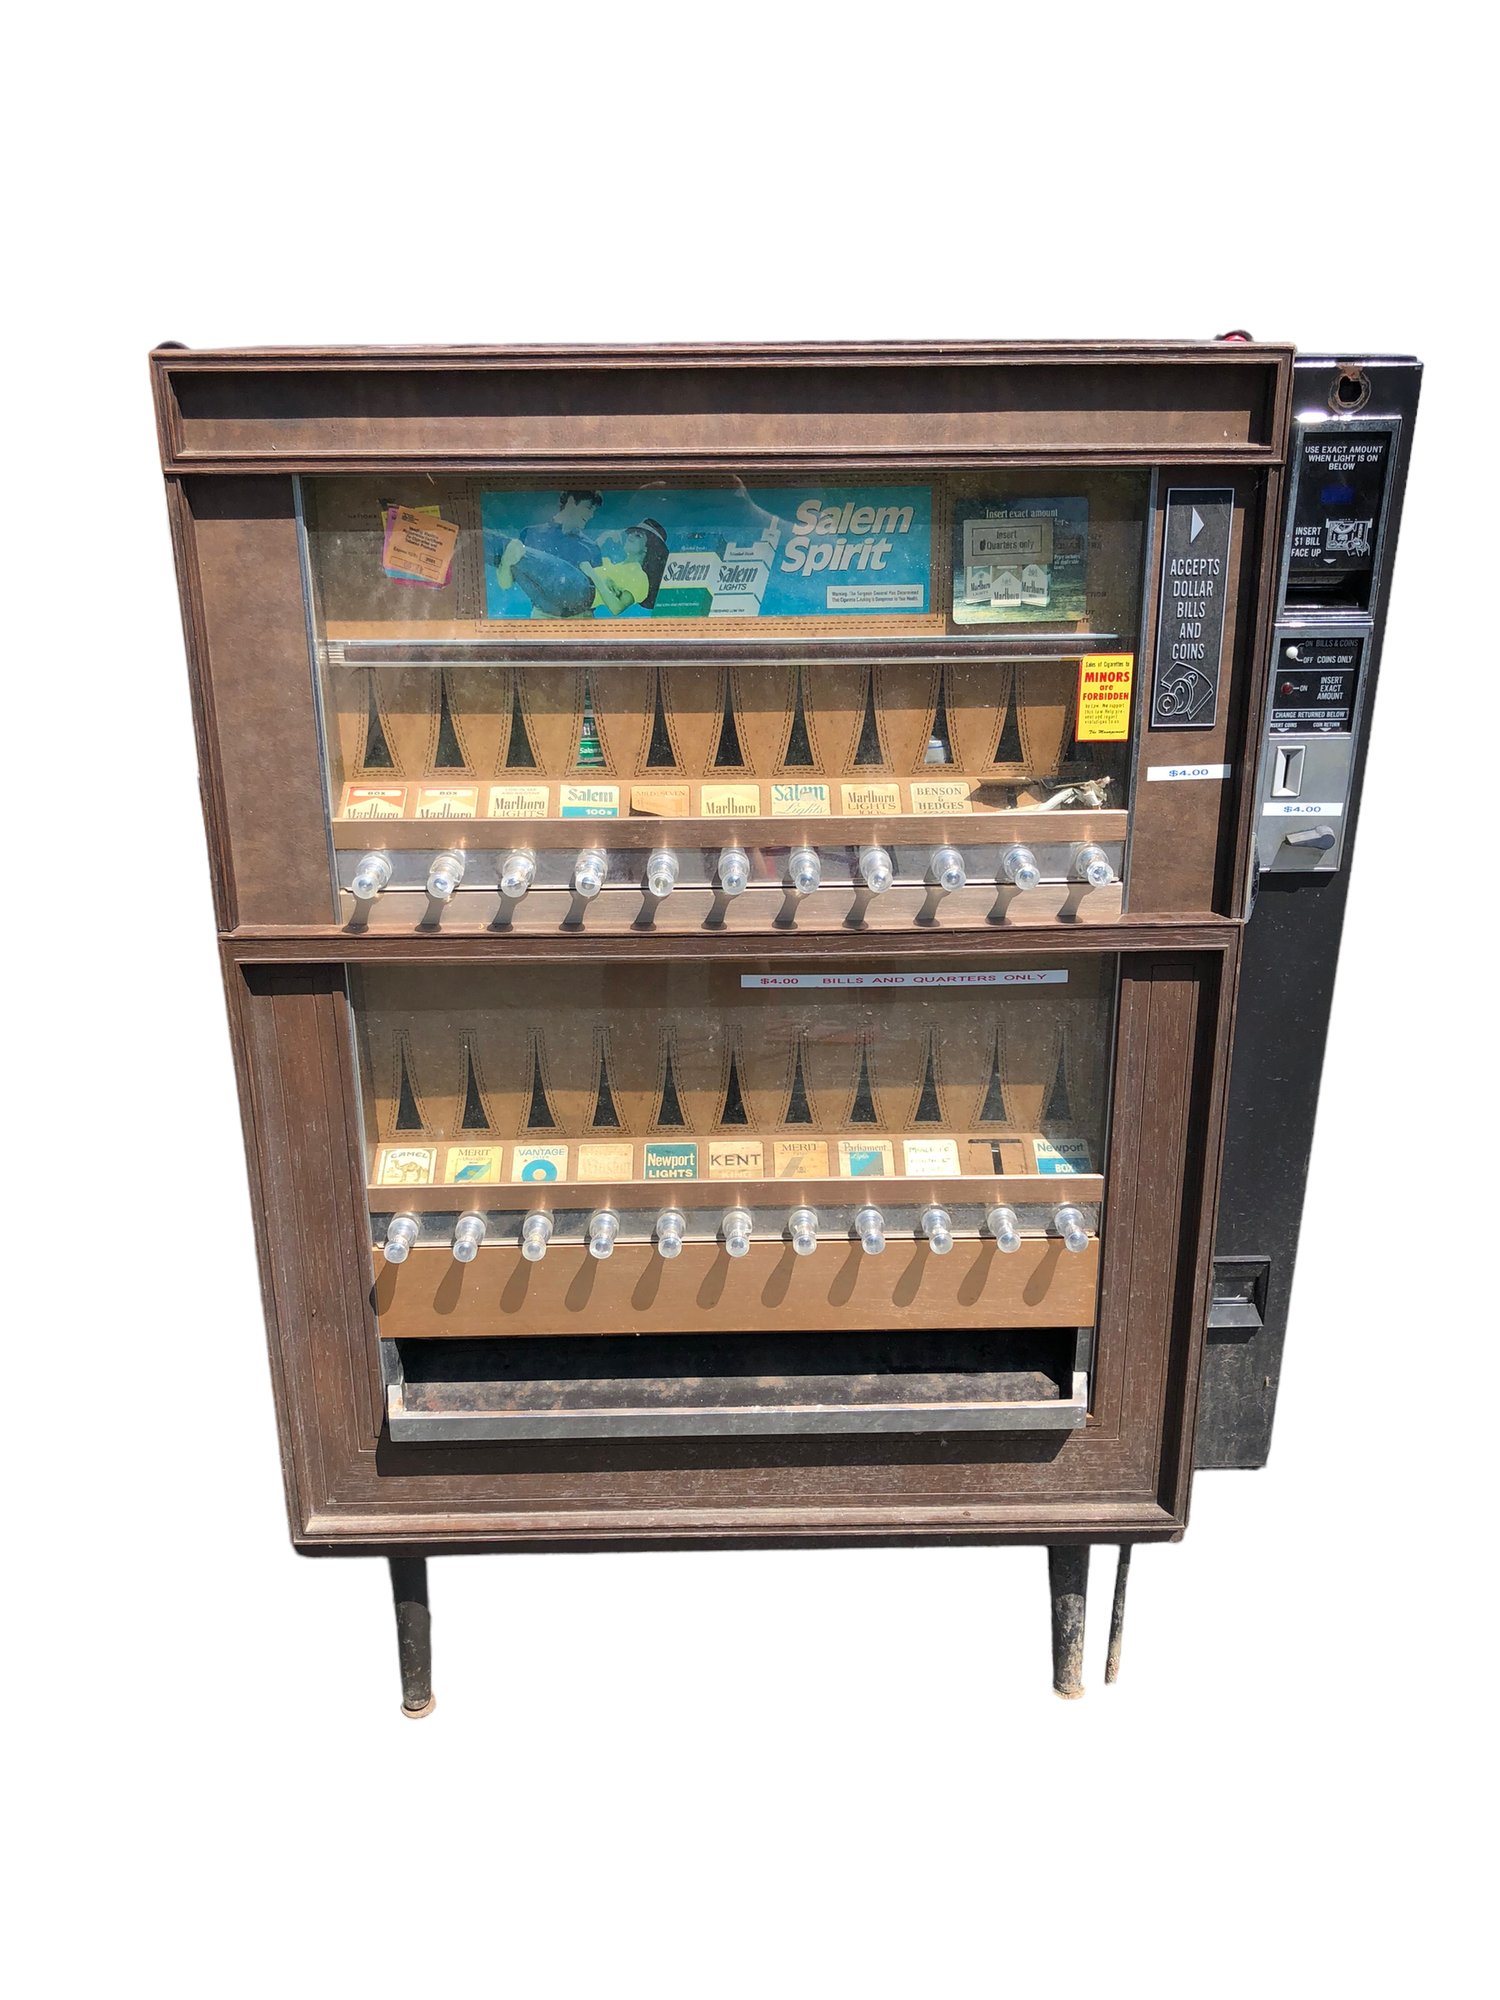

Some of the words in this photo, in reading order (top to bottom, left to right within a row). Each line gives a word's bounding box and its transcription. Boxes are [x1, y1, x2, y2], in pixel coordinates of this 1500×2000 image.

[1308, 454, 1330, 462] WHEN
[1333, 454, 1356, 462] LIGHT
[1358, 454, 1364, 462] IS
[1366, 454, 1378, 462] ON
[792, 500, 915, 536] Salem
[986, 509, 1008, 518] Insert
[1009, 510, 1028, 518] exact
[1030, 509, 1058, 518] amount
[997, 530, 1017, 539] Insert
[1295, 526, 1321, 536] INSERT
[987, 540, 1017, 550] Quarters
[1020, 540, 1034, 550] only
[1294, 537, 1303, 546] $1
[1305, 537, 1320, 546] BILL
[780, 537, 894, 577] Spirit
[1291, 549, 1308, 557] FACE
[1311, 548, 1321, 557] UP
[663, 560, 710, 582] Salem
[1170, 558, 1220, 576] ACCEPTS
[717, 566, 758, 583] Salem
[719, 583, 747, 591] LIGHTS
[1021, 581, 1045, 594] Marlboro
[1173, 580, 1213, 597] DOLLAR
[994, 587, 1019, 600] Marlboro
[1177, 602, 1205, 618] BILLS
[1180, 622, 1201, 639] AND
[1172, 643, 1204, 660] COINS
[1317, 656, 1336, 664] COINS
[1084, 672, 1130, 682] MINORS
[1321, 676, 1343, 684] INSERT
[1169, 768, 1209, 777] $4.00
[568, 788, 613, 802] Salem
[774, 784, 825, 801] Salem
[848, 790, 895, 803] Marlboro
[495, 796, 545, 810] Marlboro
[706, 797, 756, 814] Marlboro
[775, 803, 827, 815] Lights
[919, 802, 964, 810] HEDGES
[348, 803, 399, 818] Marlboro
[420, 803, 472, 818] Marlboro
[912, 975, 996, 984] QUARTERS
[518, 1148, 565, 1156] VANTAGE
[843, 1142, 886, 1151] Parliament
[1038, 1143, 1083, 1153] Newport
[648, 1152, 694, 1169] Newport
[711, 1154, 760, 1166] KENT
[1055, 1164, 1074, 1172] BOX
